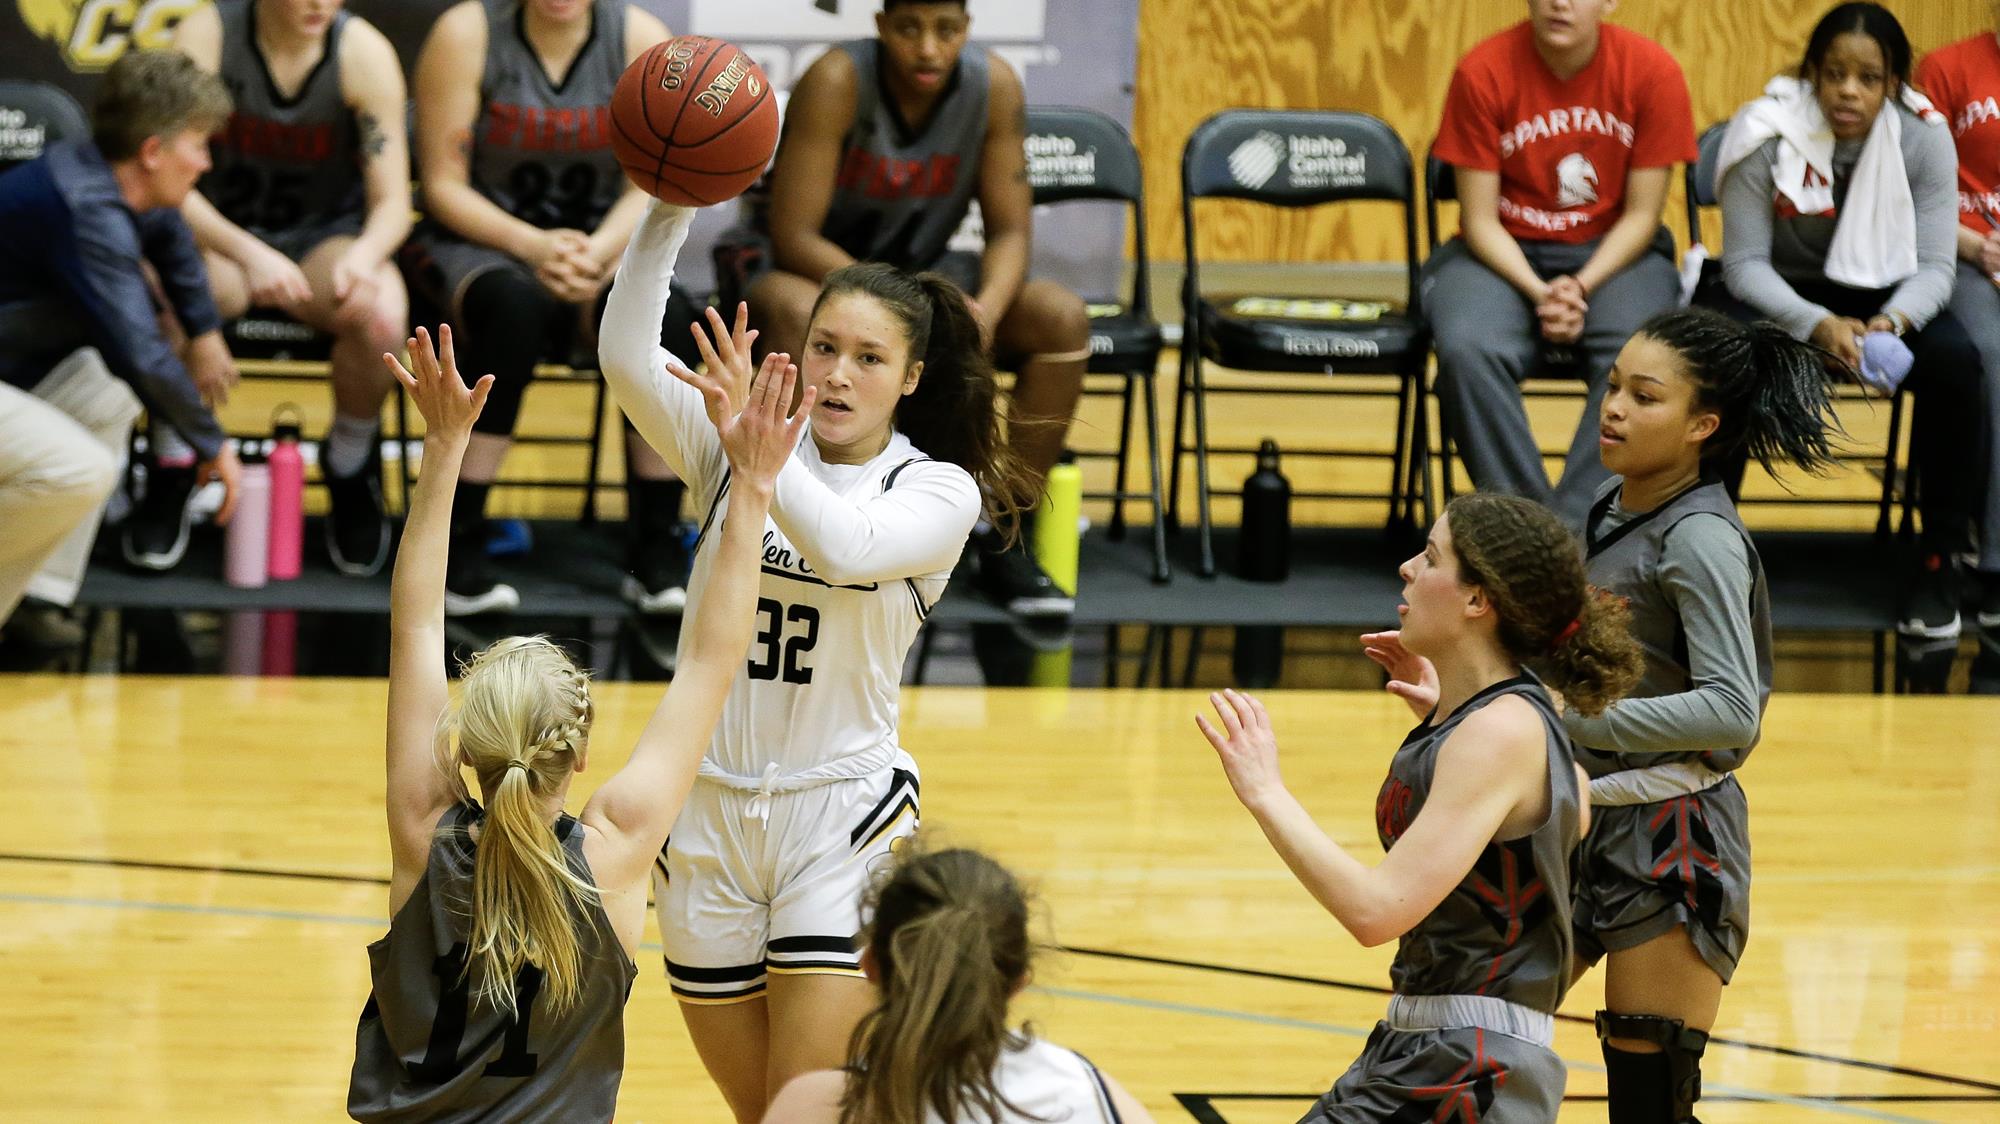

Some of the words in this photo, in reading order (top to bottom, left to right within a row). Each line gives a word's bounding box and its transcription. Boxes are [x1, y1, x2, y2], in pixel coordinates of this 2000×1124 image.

[1023, 133, 1076, 155] daho
[1500, 106, 1635, 158] SPARTANS
[1288, 151, 1366, 174] Central
[748, 597, 820, 685] 32
[407, 941, 543, 1084] 11
